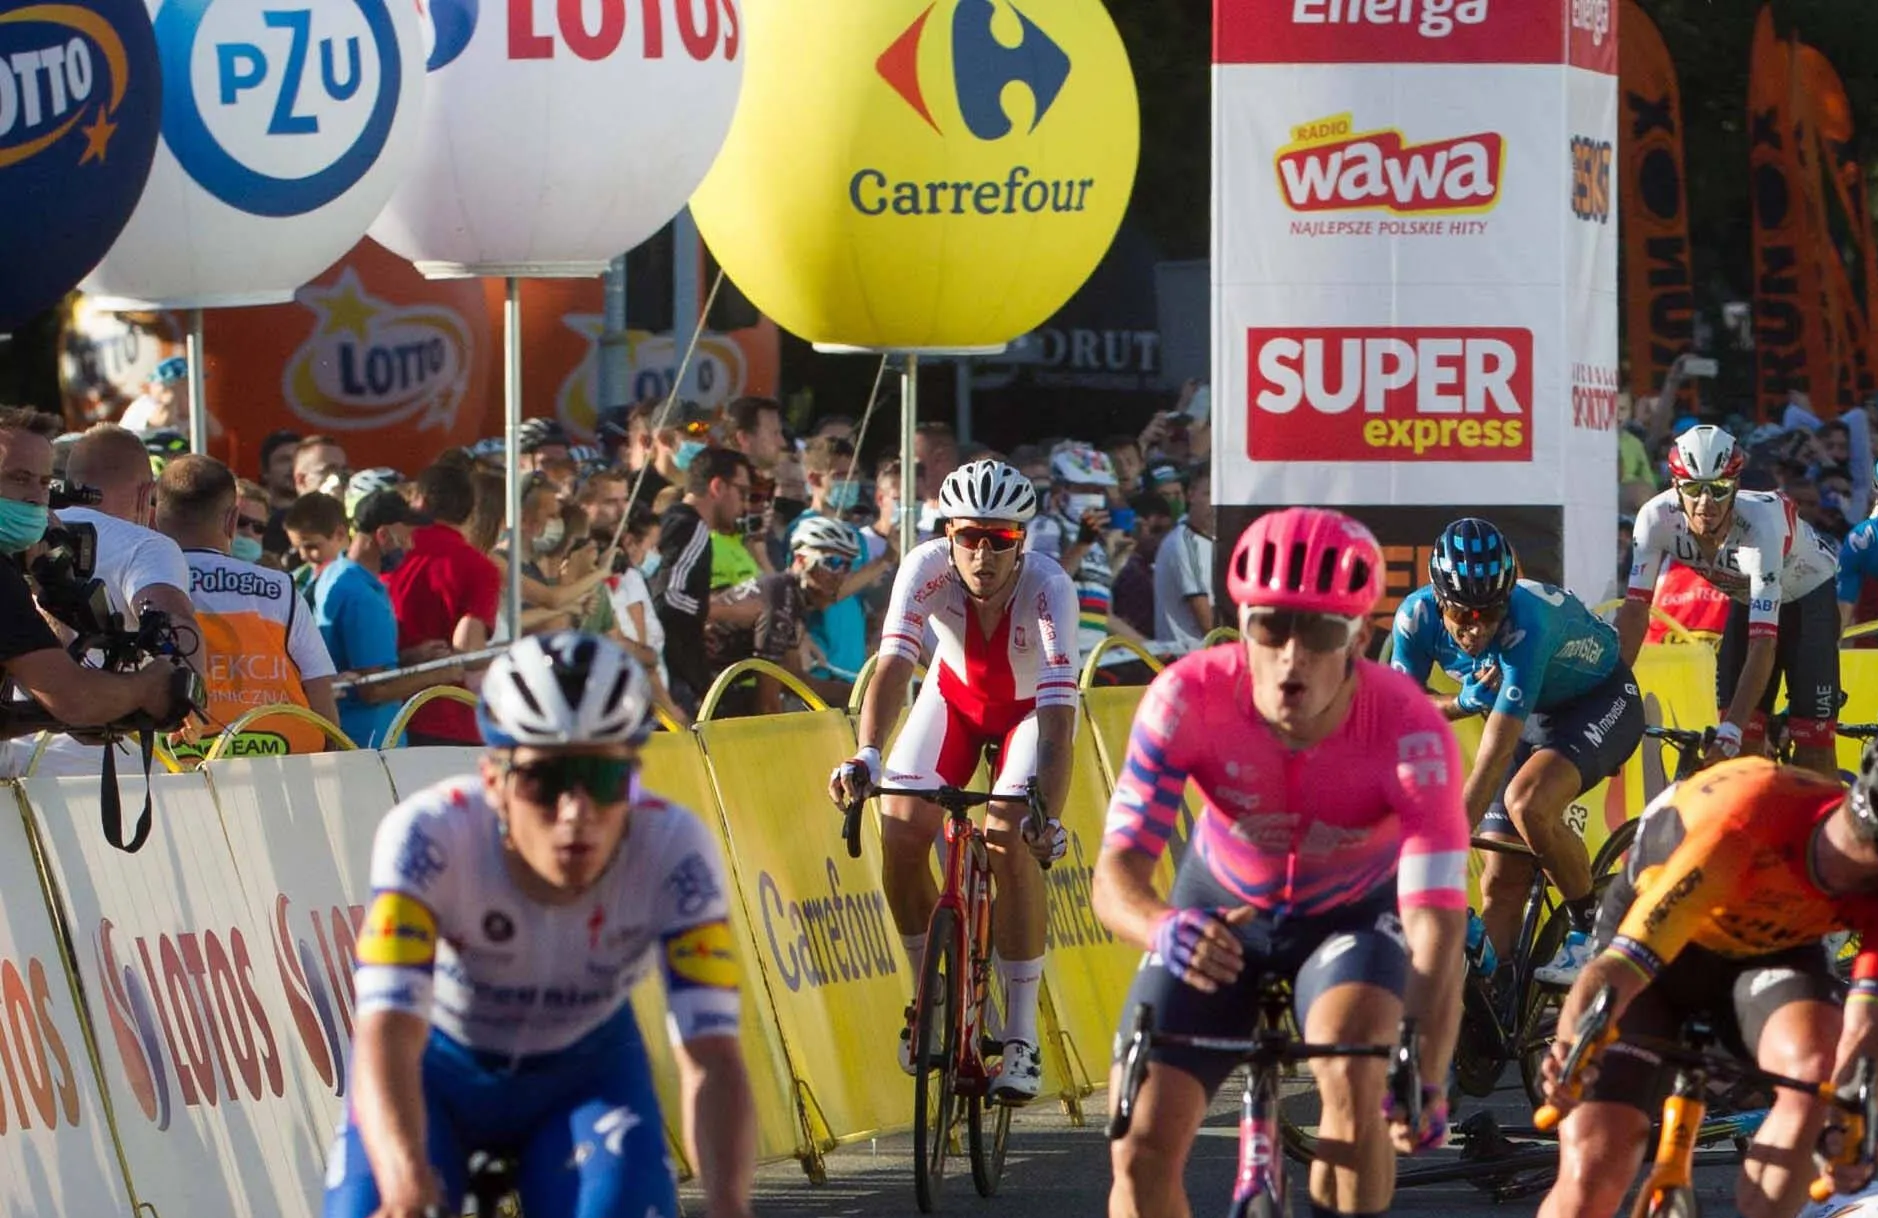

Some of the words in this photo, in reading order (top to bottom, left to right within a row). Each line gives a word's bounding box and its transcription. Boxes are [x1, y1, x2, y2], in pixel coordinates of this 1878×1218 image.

[216, 8, 363, 136] PZU
[849, 166, 1094, 216] Carrefour
[1280, 141, 1495, 205] wawa
[1289, 220, 1373, 237] NAJLEPSZE
[1378, 220, 1445, 236] POLSKIE
[1449, 220, 1489, 236] HITY
[338, 337, 446, 397] LOTTO
[1256, 337, 1523, 414] SUPER
[1363, 418, 1523, 455] express
[189, 566, 282, 600] Pologne
[1816, 685, 1832, 718] UAE
[758, 856, 897, 992] Carrefour
[134, 925, 285, 1108] LOTOS
